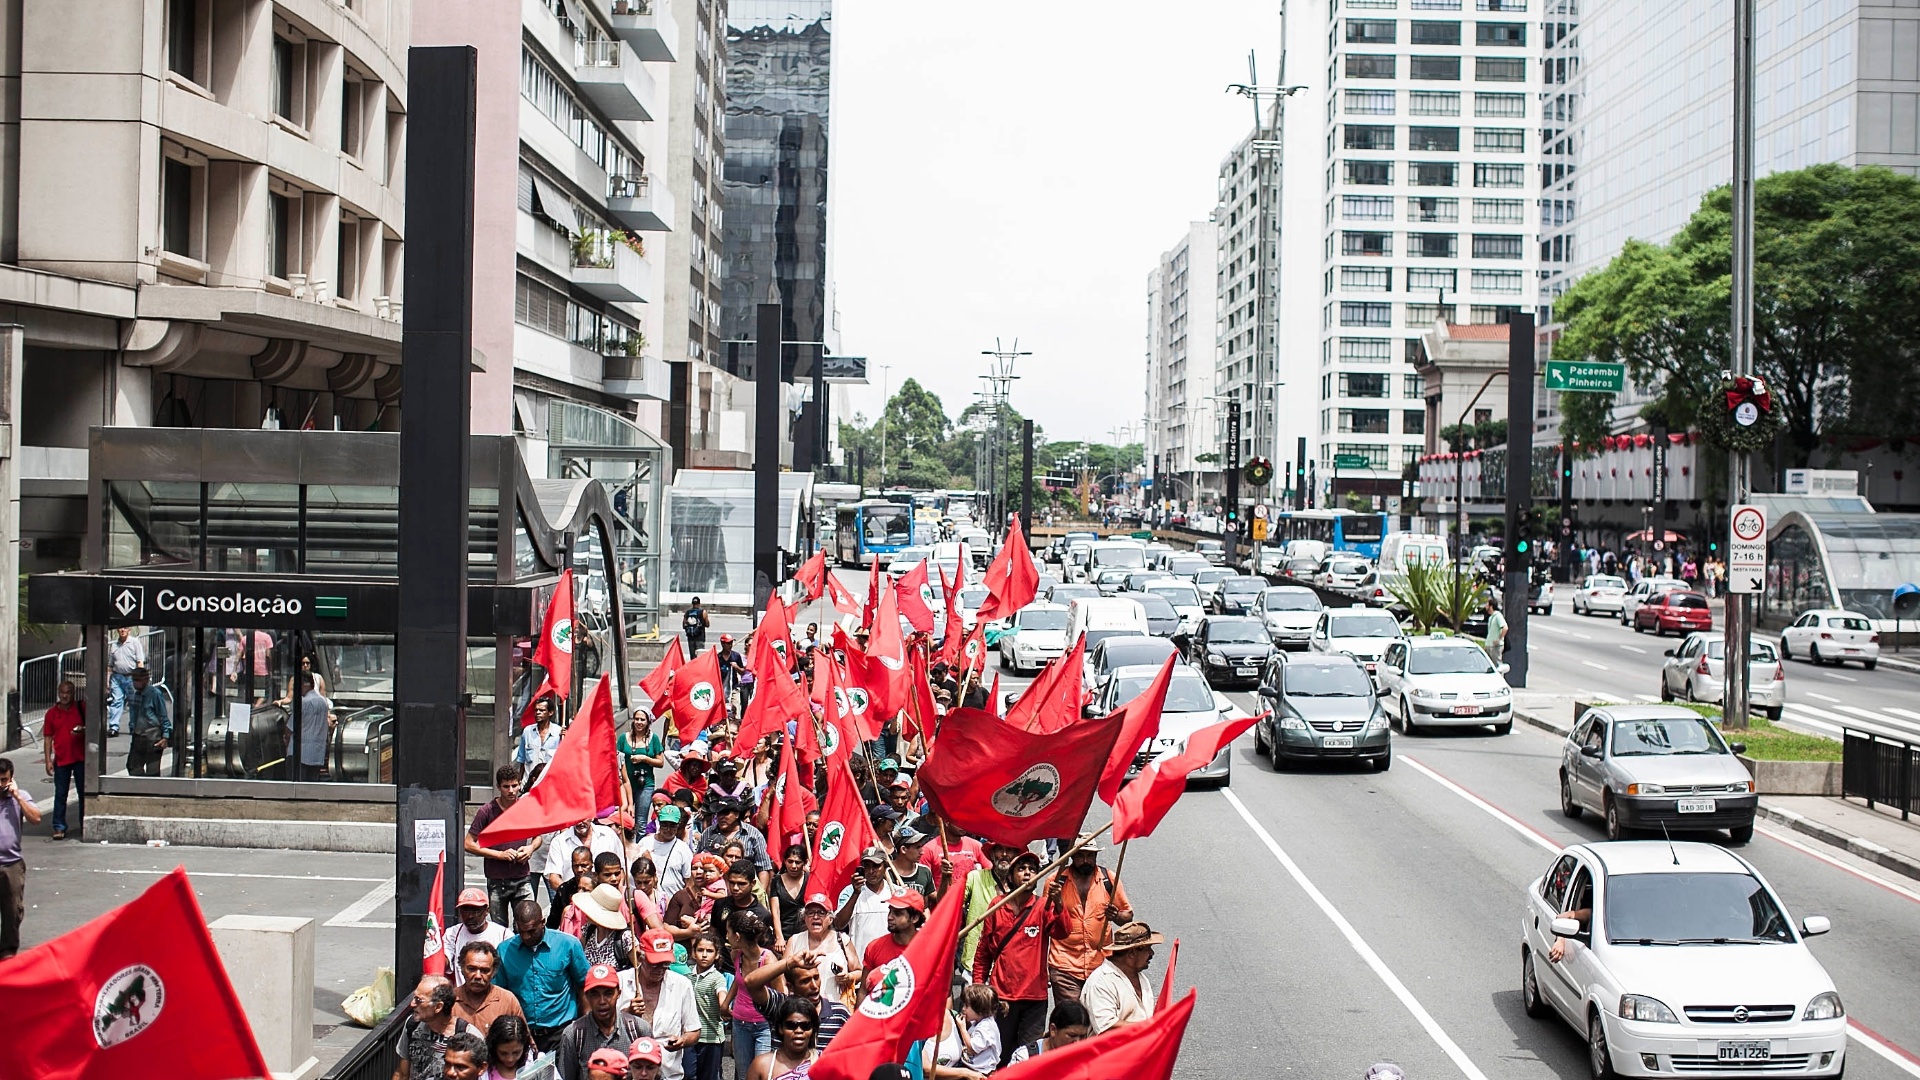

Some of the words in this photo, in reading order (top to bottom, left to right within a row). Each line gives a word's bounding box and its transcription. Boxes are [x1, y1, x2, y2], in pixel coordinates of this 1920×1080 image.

[1570, 366, 1619, 377] Pacaembu
[1569, 378, 1613, 388] Pinheiros
[156, 588, 302, 618] Consolação
[125, 1020, 149, 1038] BRASIL
[1720, 1047, 1769, 1059] DTA-1226
